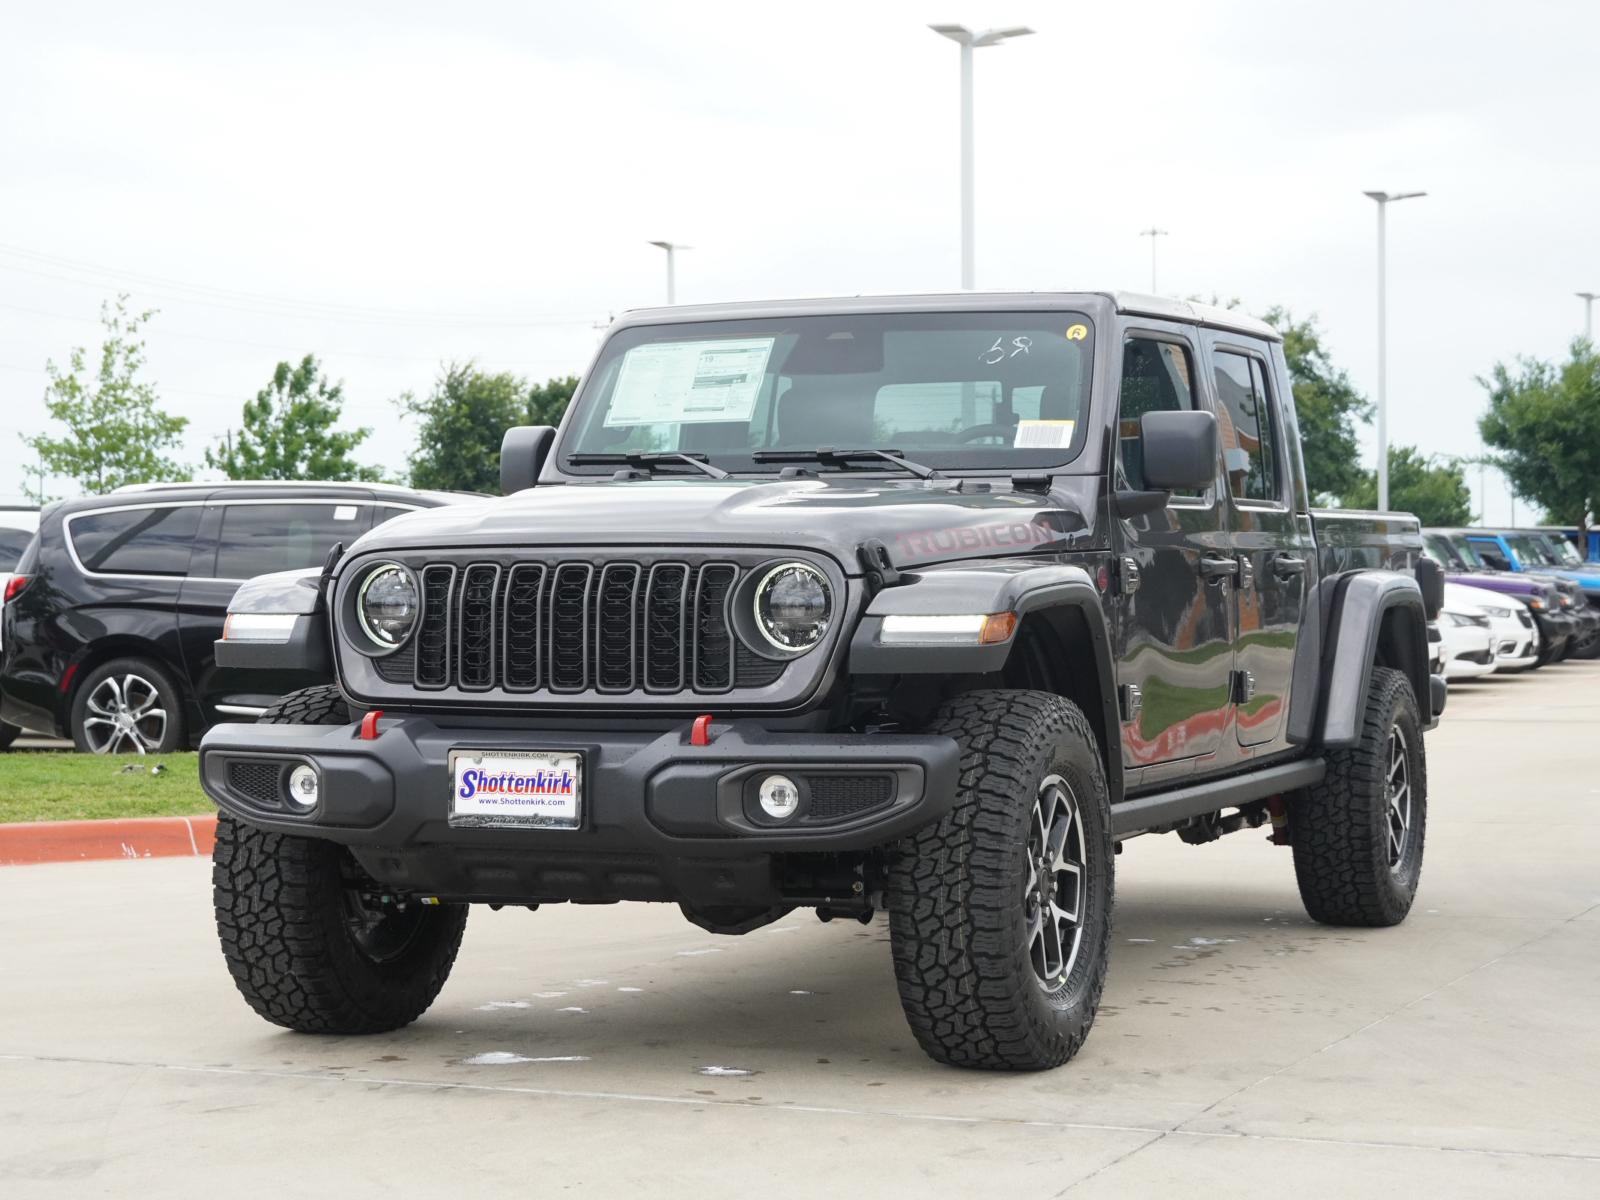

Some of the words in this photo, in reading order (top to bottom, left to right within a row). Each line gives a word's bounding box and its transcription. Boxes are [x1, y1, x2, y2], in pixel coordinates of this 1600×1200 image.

[704, 355, 714, 363] 19
[896, 521, 1055, 557] RUBICON
[459, 769, 574, 799] Shottenkirk
[478, 798, 566, 806] www.Shottenkirk.com
